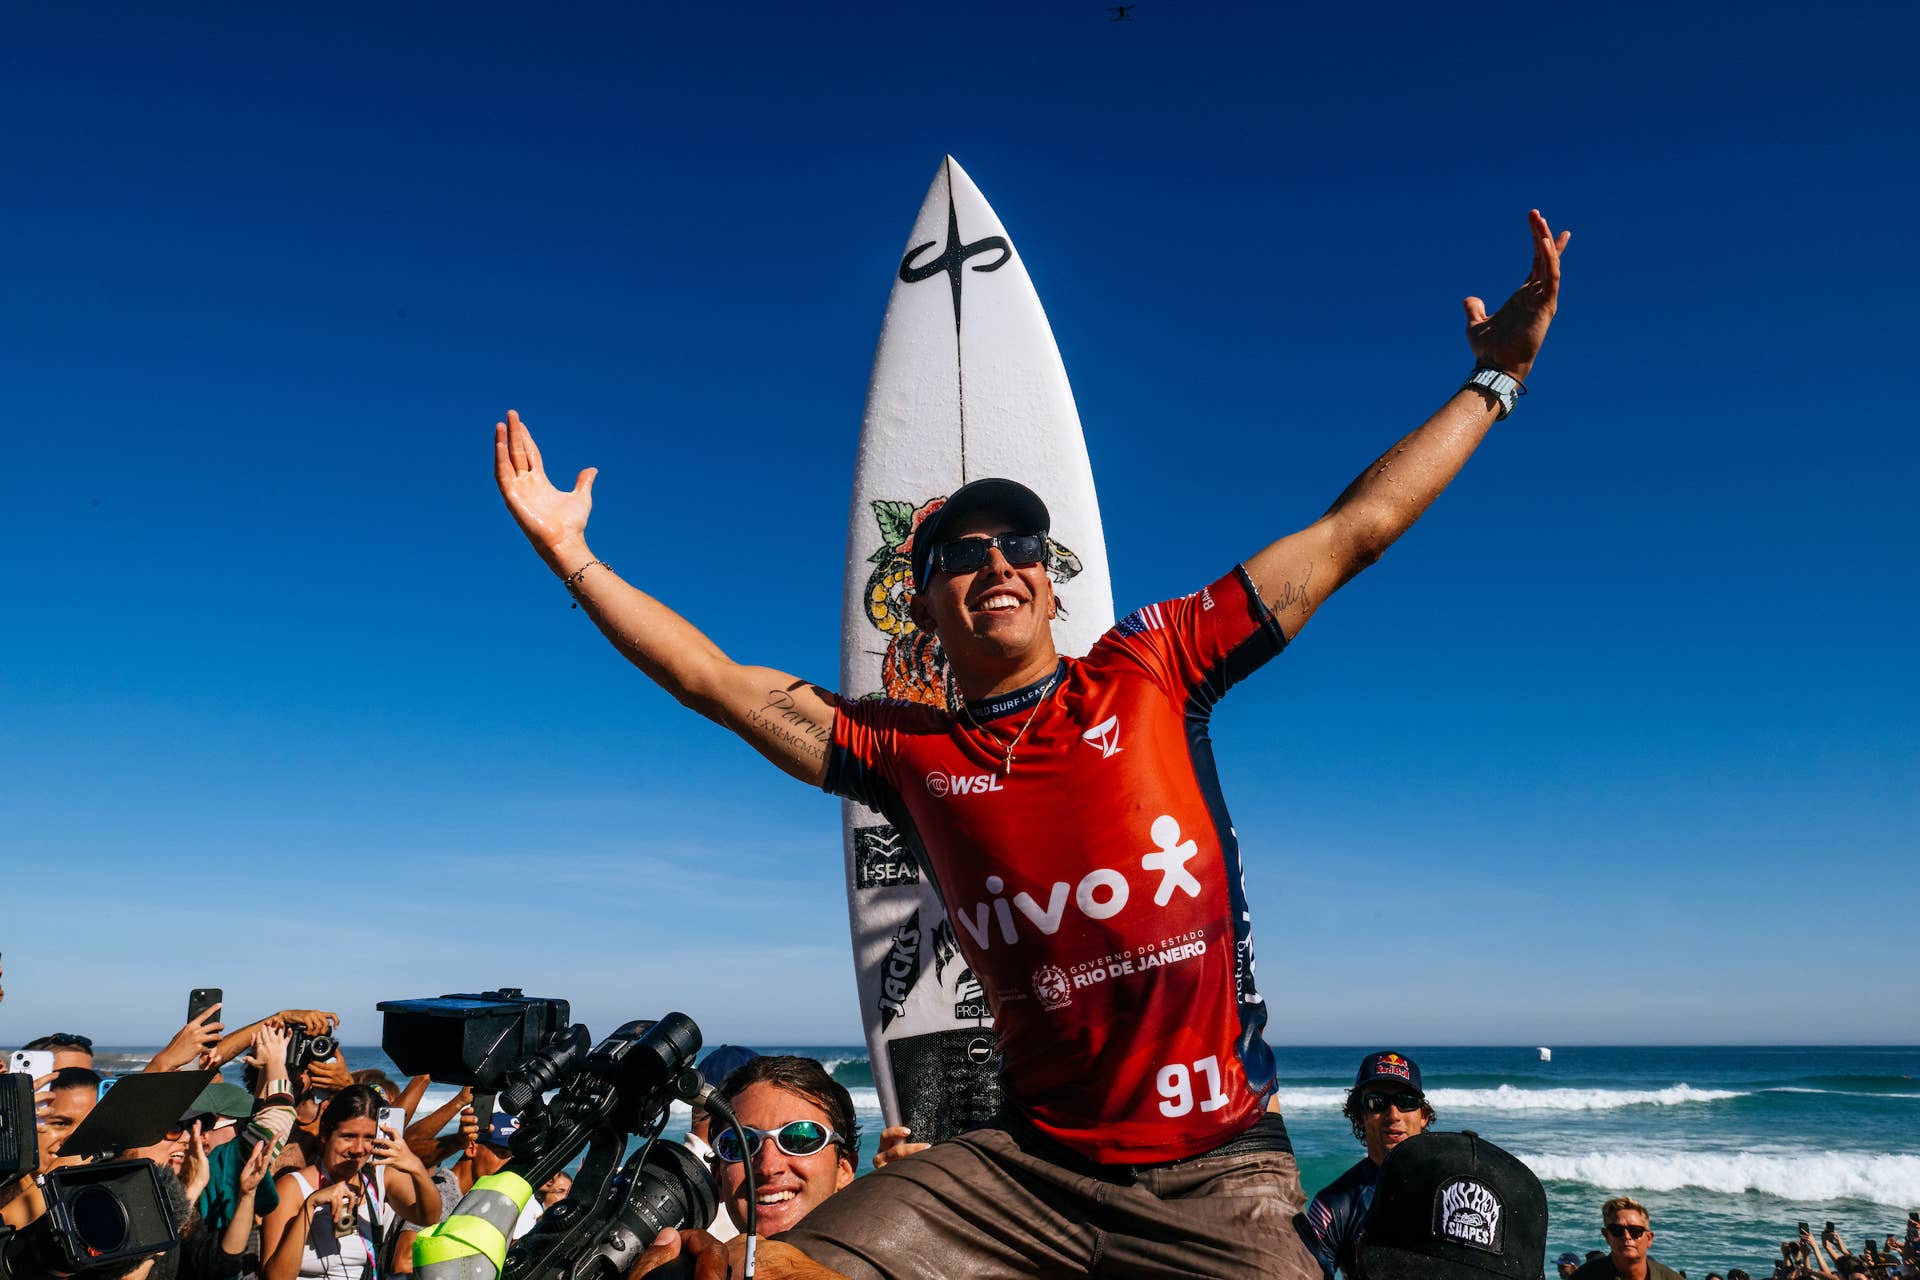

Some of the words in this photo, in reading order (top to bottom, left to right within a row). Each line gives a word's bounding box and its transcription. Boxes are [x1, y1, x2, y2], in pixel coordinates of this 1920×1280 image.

[992, 698, 1021, 714] SURF
[950, 773, 1004, 796] WSL
[863, 862, 912, 881] I-SEA
[957, 868, 1130, 950] vivo
[1070, 950, 1132, 974] GOVERNO
[1138, 943, 1155, 955] DO
[1160, 929, 1204, 948] ESTADO
[1073, 968, 1107, 989] RIO
[1108, 950, 1135, 978] DE
[1137, 940, 1207, 971] JANEIRO
[1234, 936, 1250, 1004] natura
[956, 1004, 990, 1017] PRO-L
[1156, 1054, 1230, 1118] 91
[1447, 1221, 1490, 1245] SHAPES
